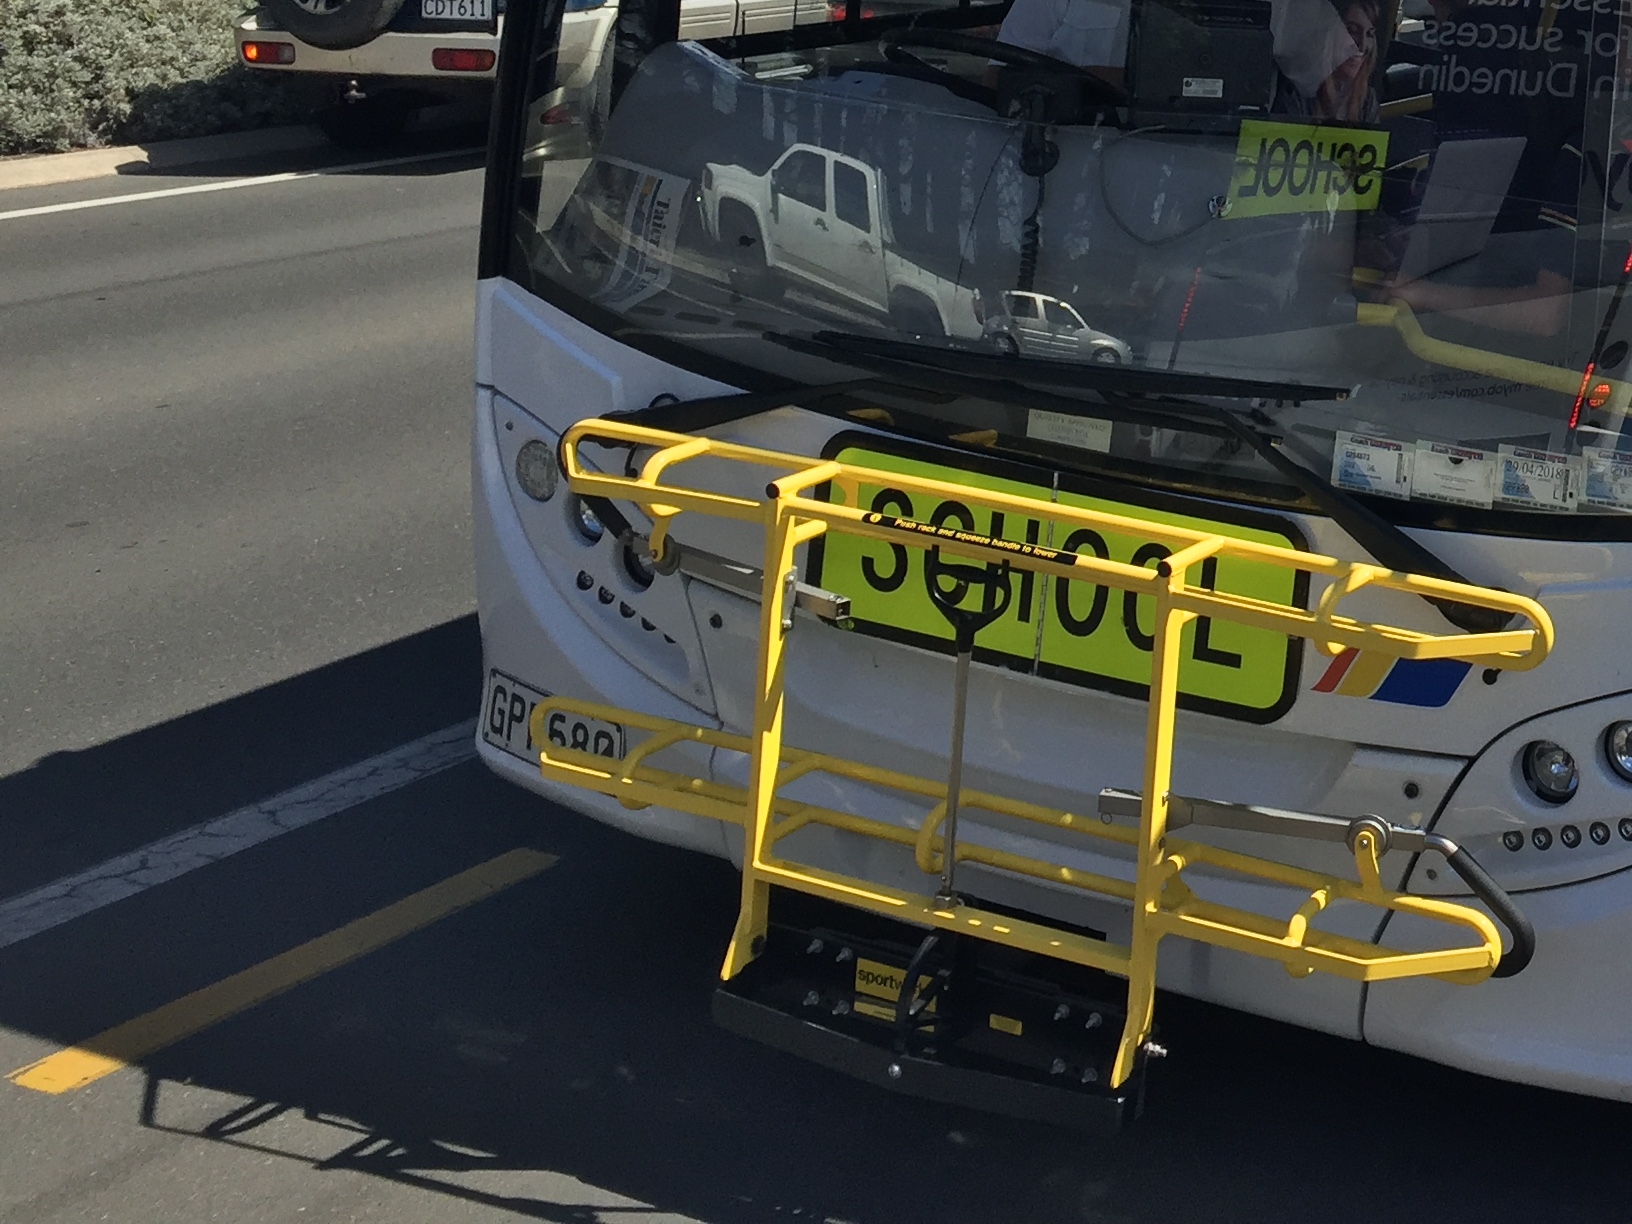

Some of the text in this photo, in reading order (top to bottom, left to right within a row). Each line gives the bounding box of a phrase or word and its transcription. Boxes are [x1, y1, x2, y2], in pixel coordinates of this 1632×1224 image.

[1505, 459, 1562, 480] 29/04/2018
[894, 518, 1058, 559] Push rack and squeeze handle to lower
[862, 487, 1242, 669] SCHOOL
